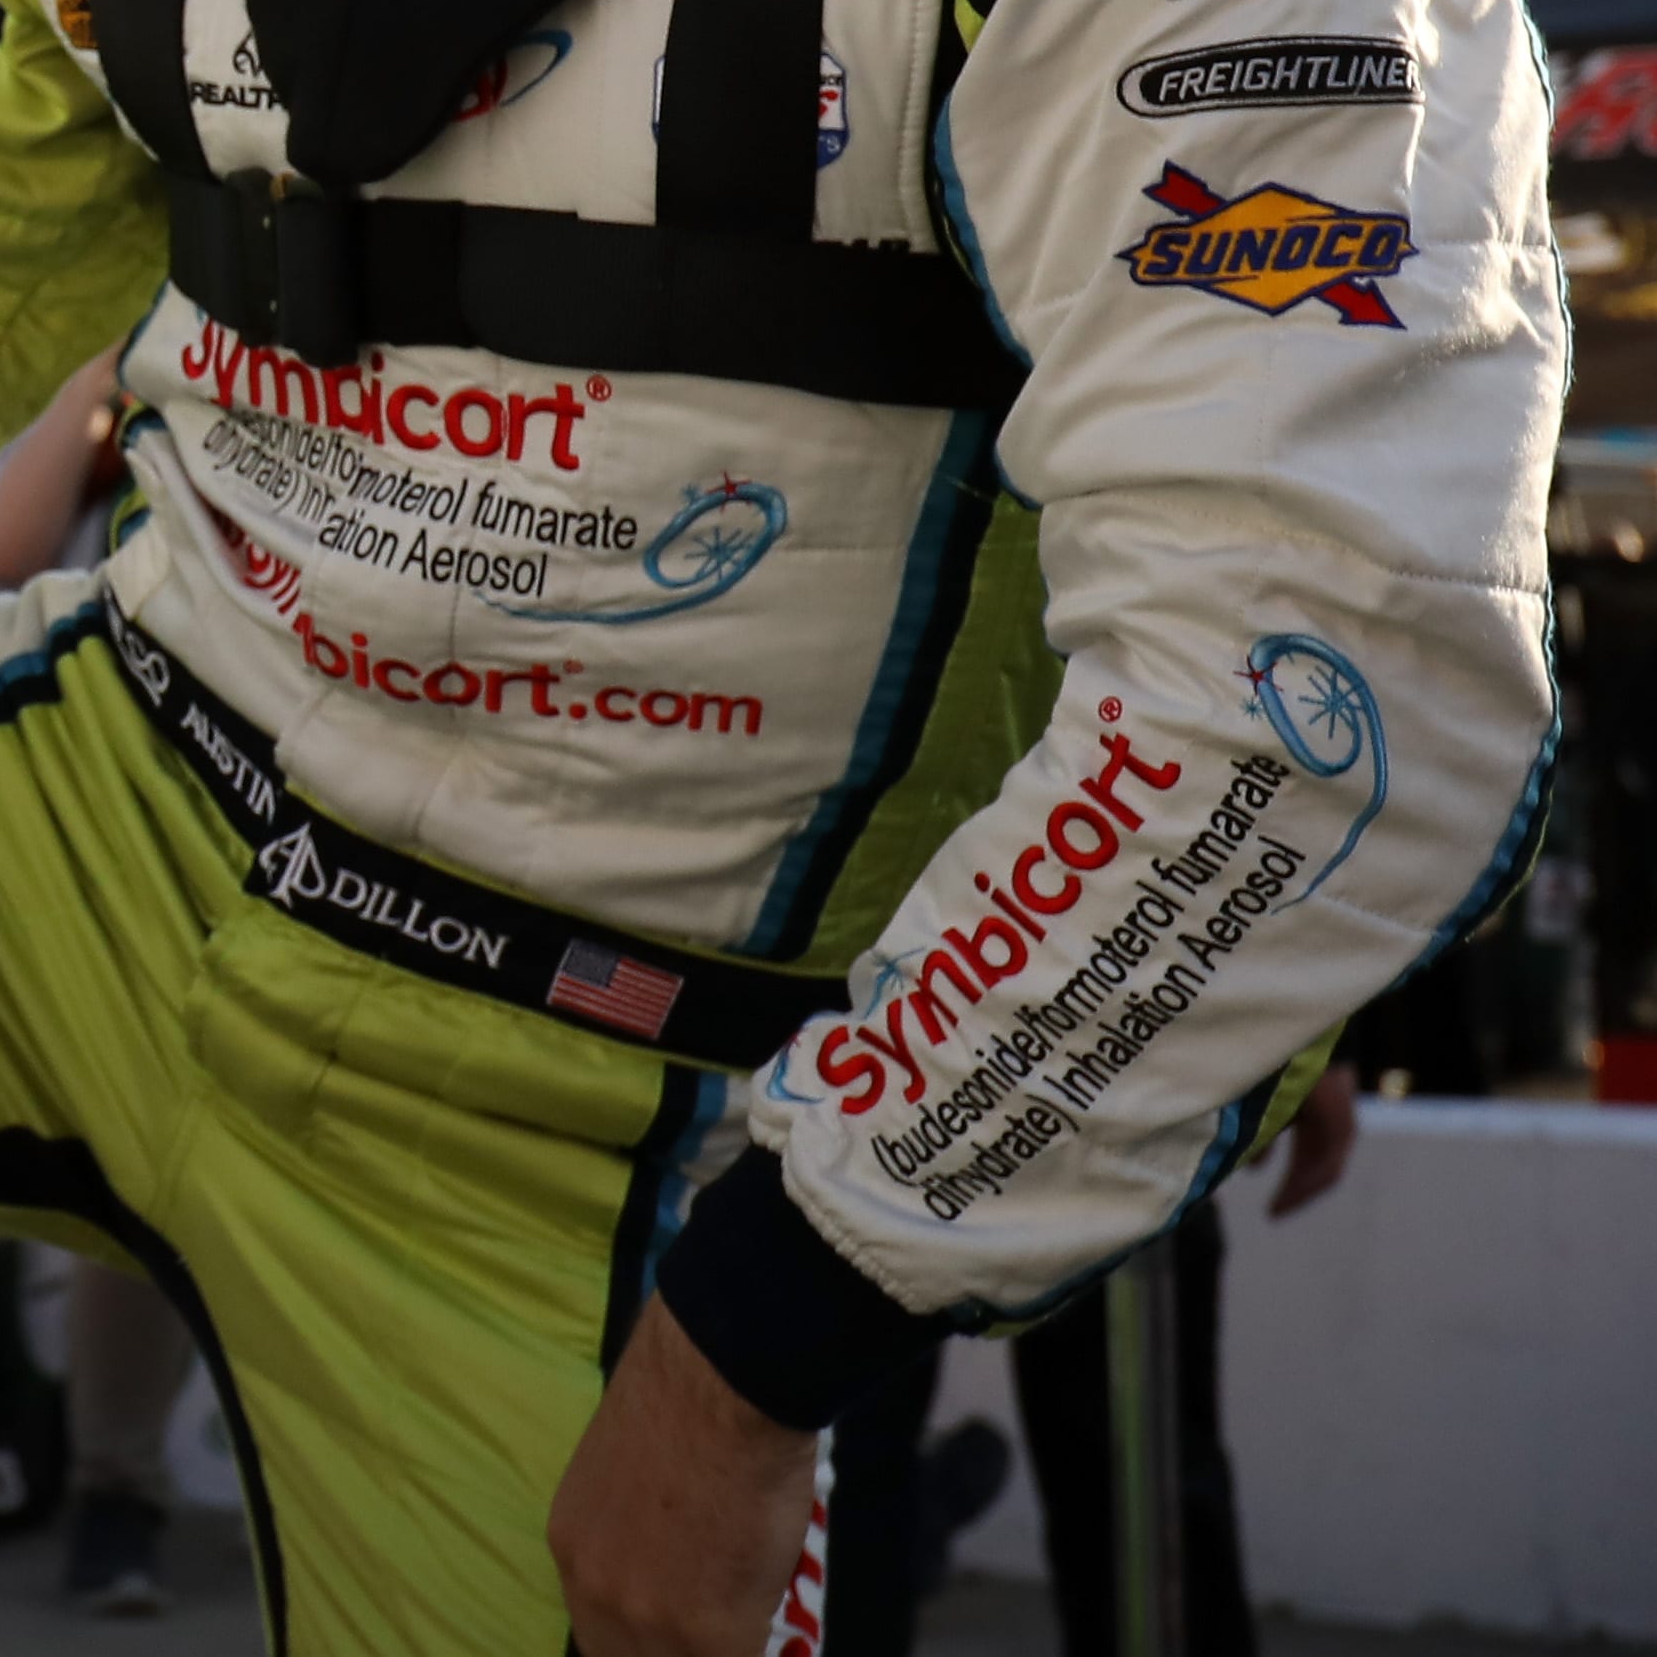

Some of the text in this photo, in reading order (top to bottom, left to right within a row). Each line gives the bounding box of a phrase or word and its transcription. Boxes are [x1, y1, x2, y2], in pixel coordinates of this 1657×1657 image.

[1159, 55, 1420, 103] FREIGHTLINER
[1143, 223, 1406, 276] SUNOCO
[472, 480, 638, 552] fumarate
[400, 528, 549, 598] Aerosol
[180, 703, 277, 827] AUSTIN
[328, 864, 510, 970] DILLON
[1151, 749, 1292, 914] fumarate
[1043, 961, 1208, 1112] Inhalation
[1184, 836, 1307, 973] Aerosol
